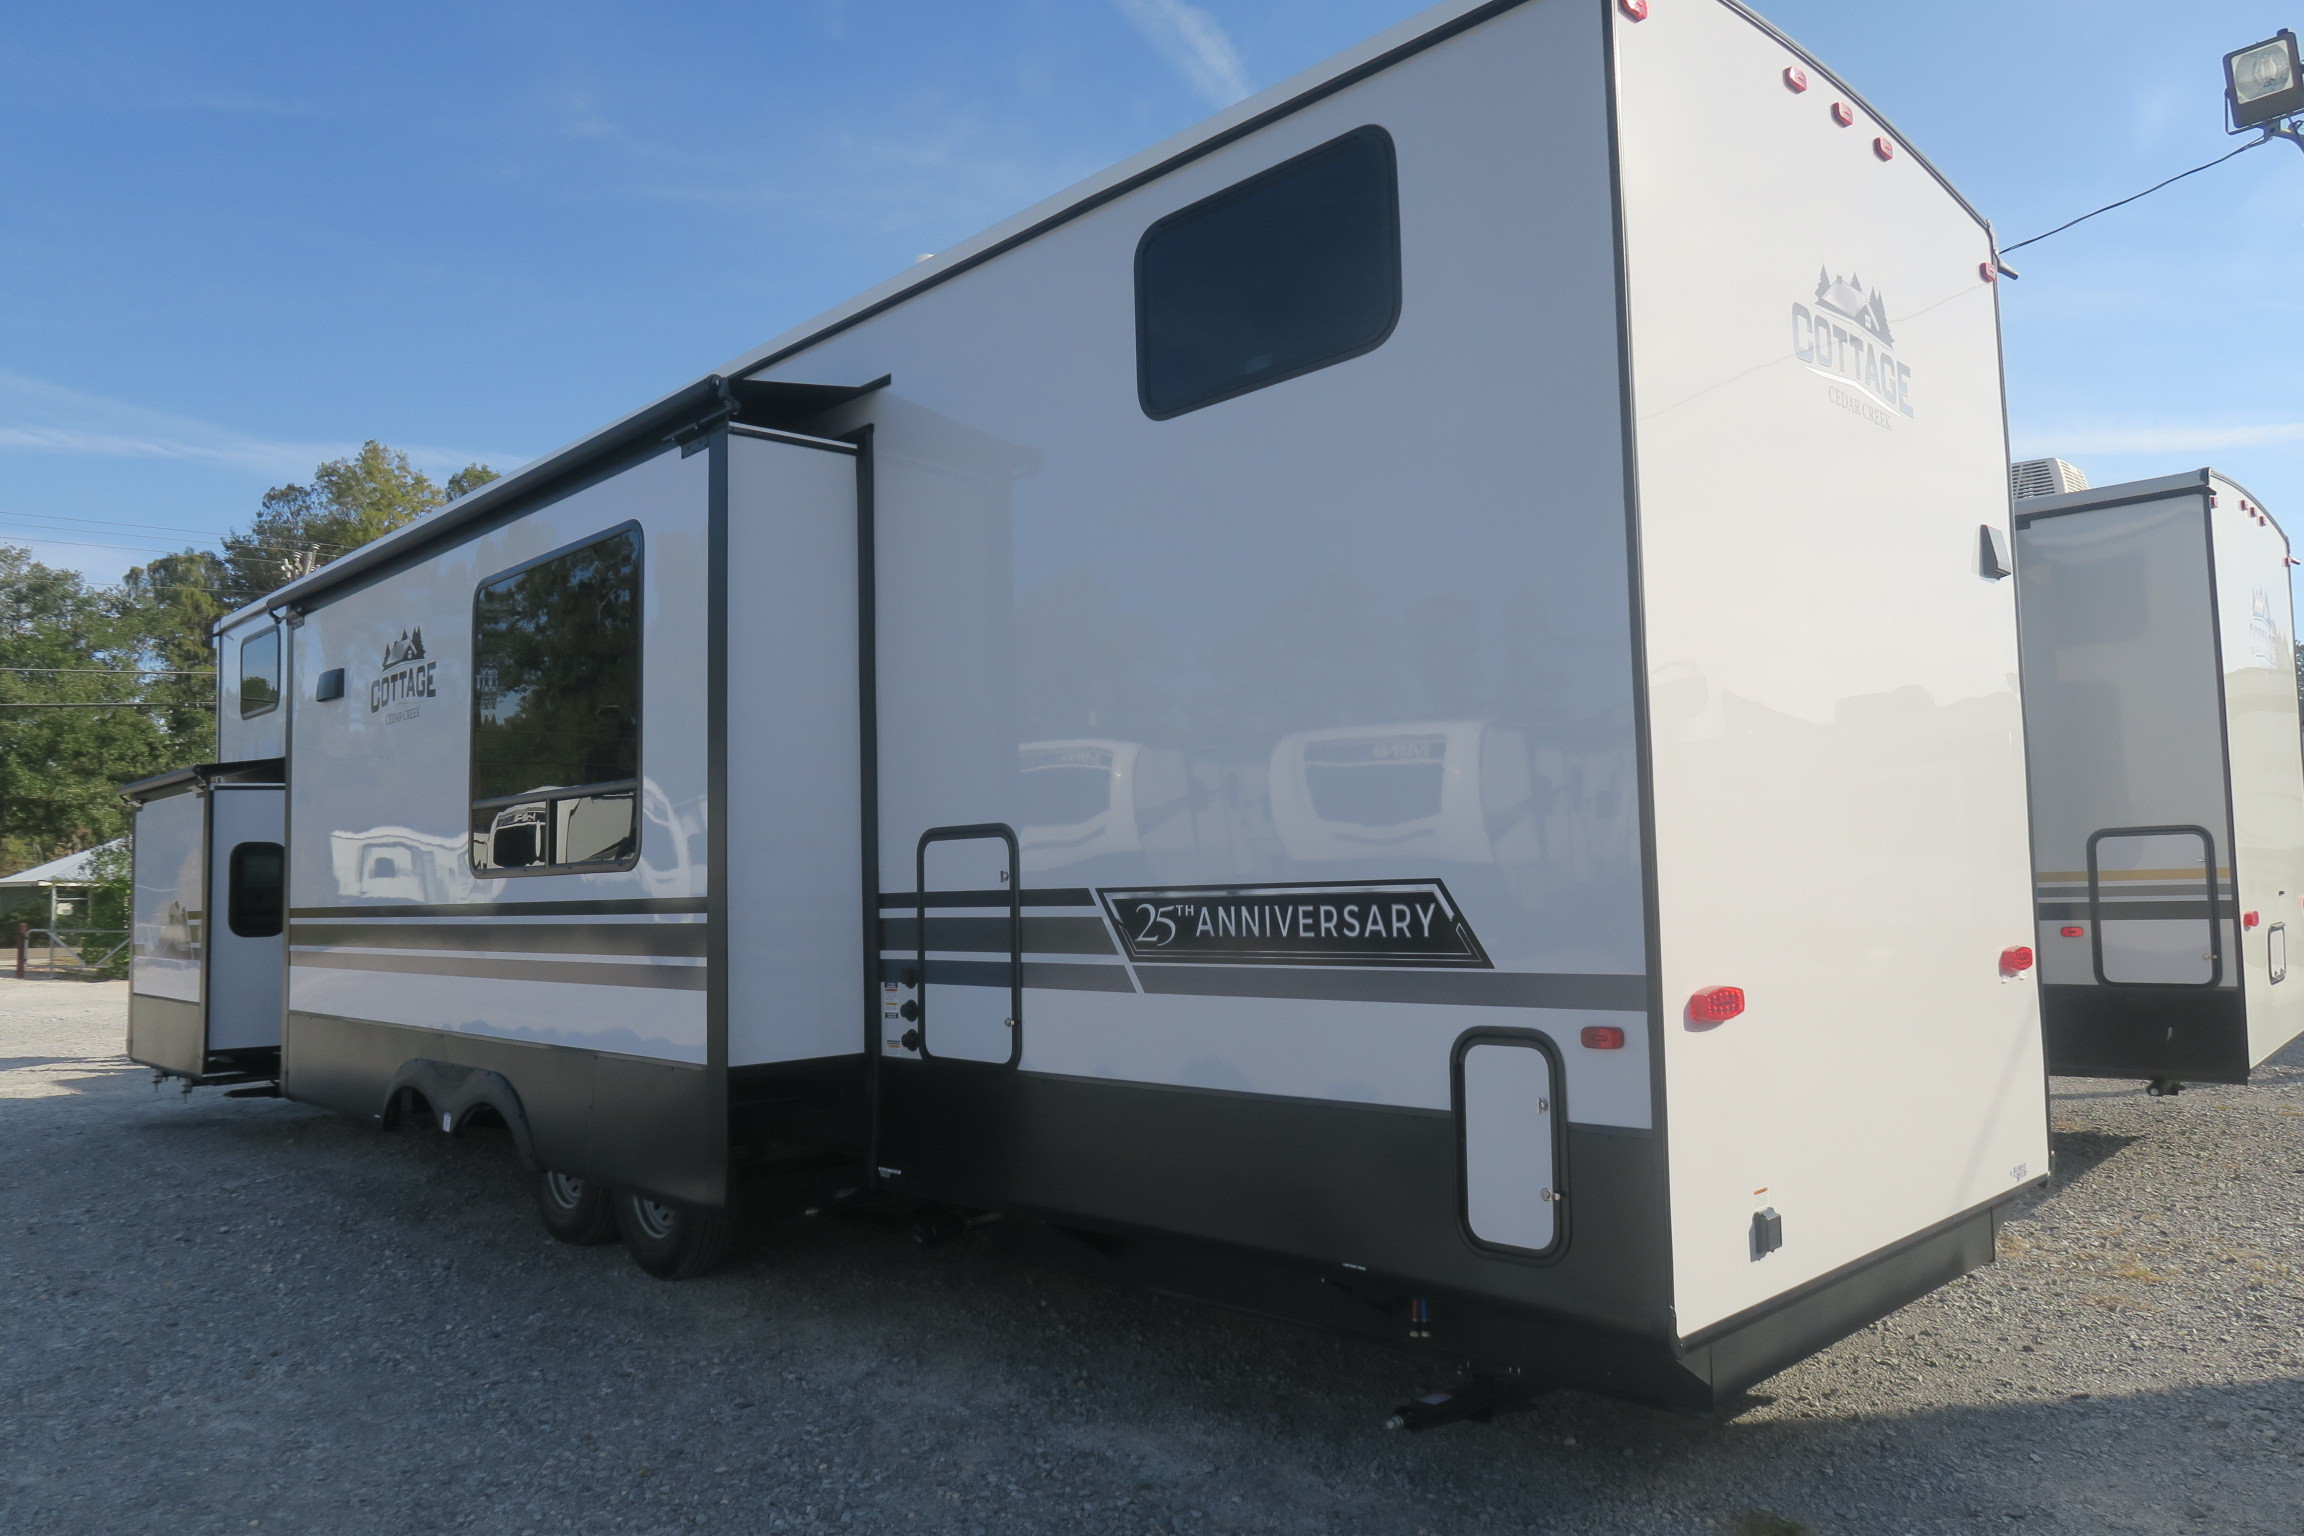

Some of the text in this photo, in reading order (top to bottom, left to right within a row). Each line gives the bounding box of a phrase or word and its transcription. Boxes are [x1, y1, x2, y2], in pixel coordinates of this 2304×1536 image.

[1791, 301, 1914, 419] COTTAGE
[1828, 386, 1892, 431] CEDAR CREEK
[370, 661, 437, 714] COTTAGE
[1133, 903, 1437, 947] 25TH ANNIVERSARY
